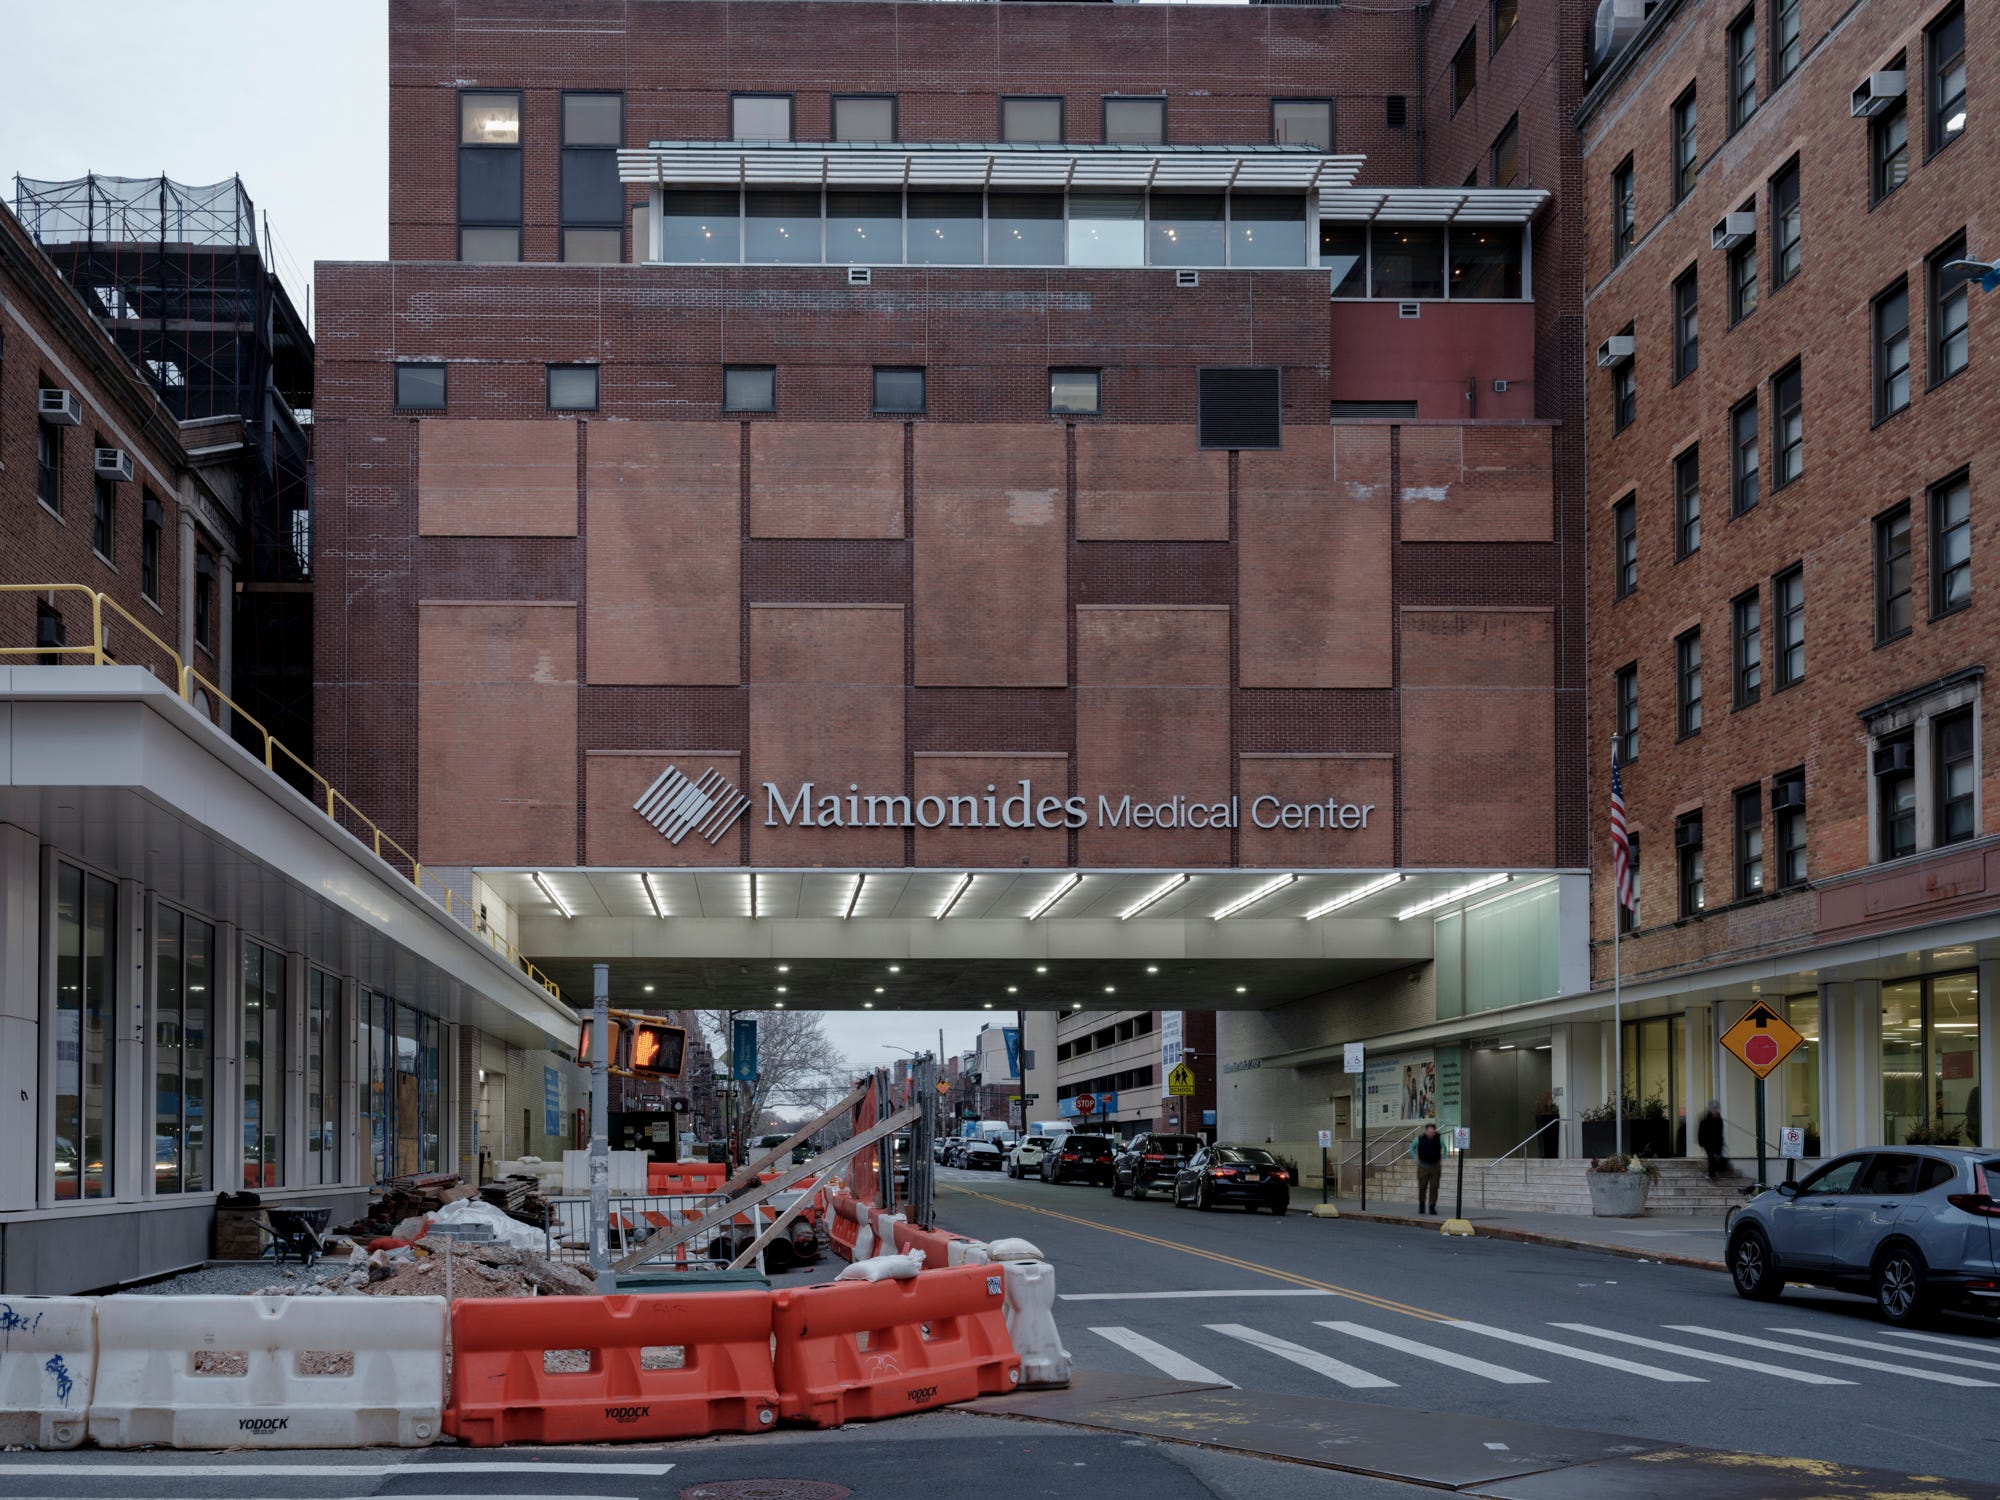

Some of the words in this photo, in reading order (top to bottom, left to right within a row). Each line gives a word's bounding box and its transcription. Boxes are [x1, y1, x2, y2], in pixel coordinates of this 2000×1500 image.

[763, 780, 1088, 828] Maimonides
[1098, 795, 1239, 829] Medical
[1251, 795, 1375, 829] Center
[1076, 1099, 1095, 1109] STOP
[907, 1385, 938, 1400] YODOCK
[605, 1406, 650, 1418] YODOCK
[239, 1417, 288, 1430] YODOCK
